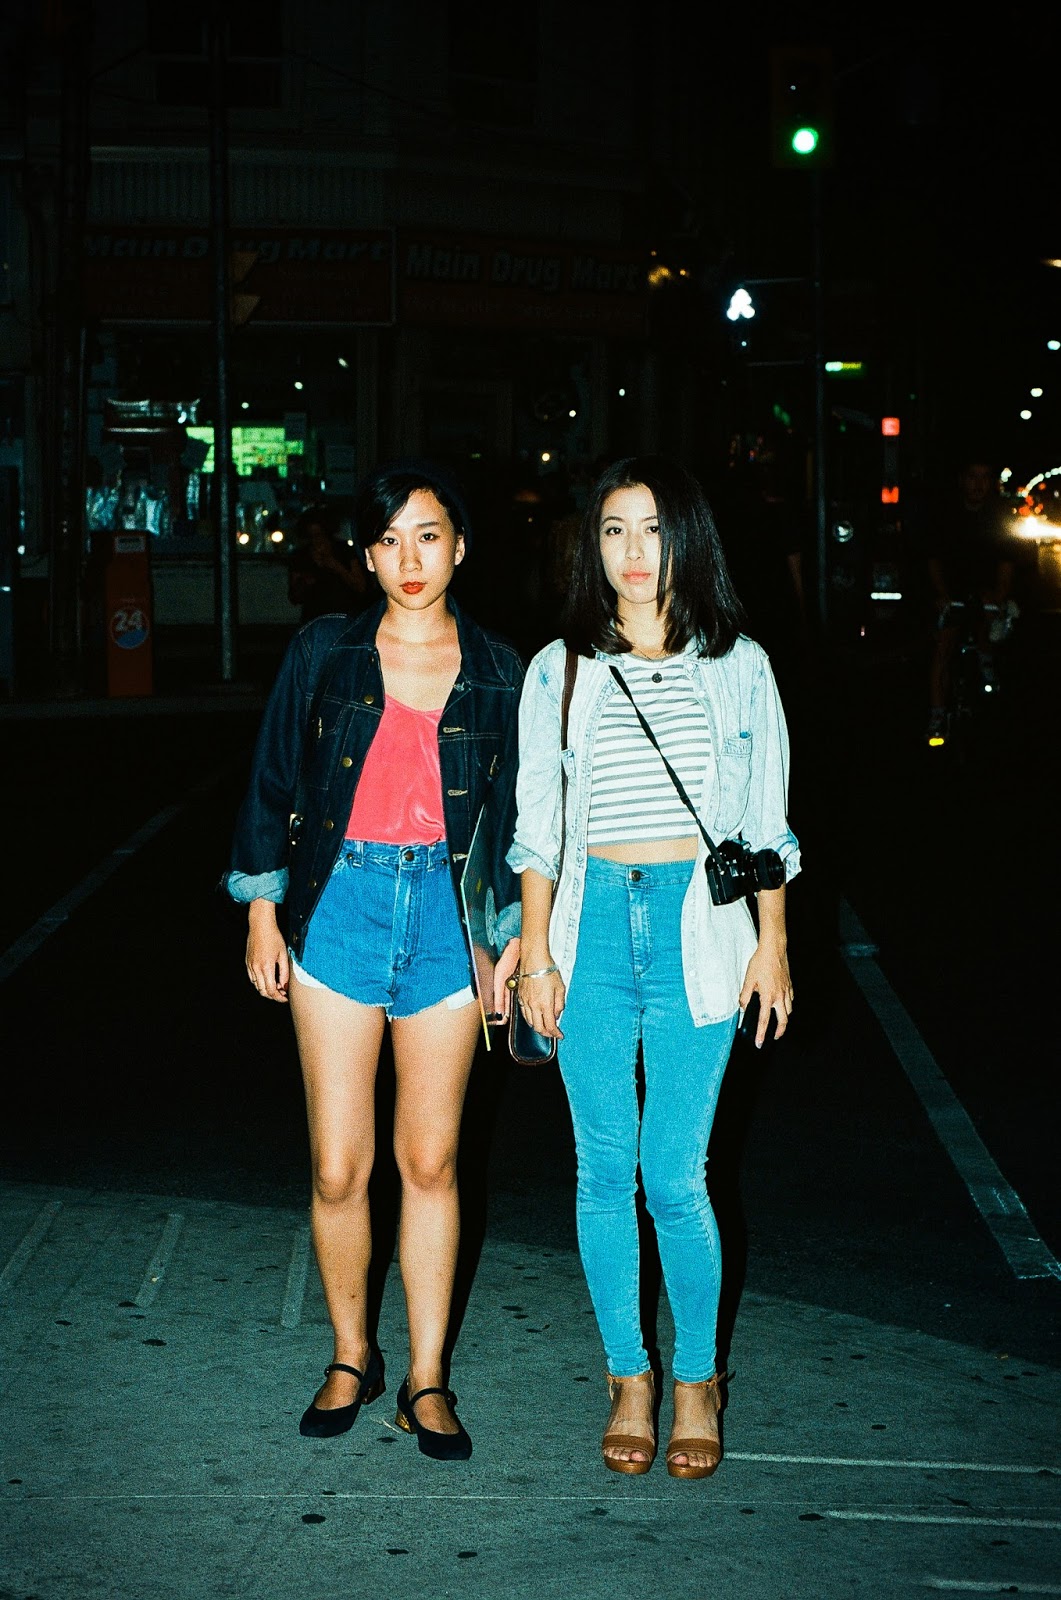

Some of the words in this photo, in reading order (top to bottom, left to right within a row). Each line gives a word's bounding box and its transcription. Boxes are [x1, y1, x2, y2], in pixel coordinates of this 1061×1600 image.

[84, 236, 178, 257] Main
[182, 236, 281, 264] Dug
[287, 238, 385, 261] Mart
[406, 244, 480, 280] Main
[491, 249, 561, 292] Drug
[571, 255, 639, 292] Mart
[114, 609, 143, 632] 24
